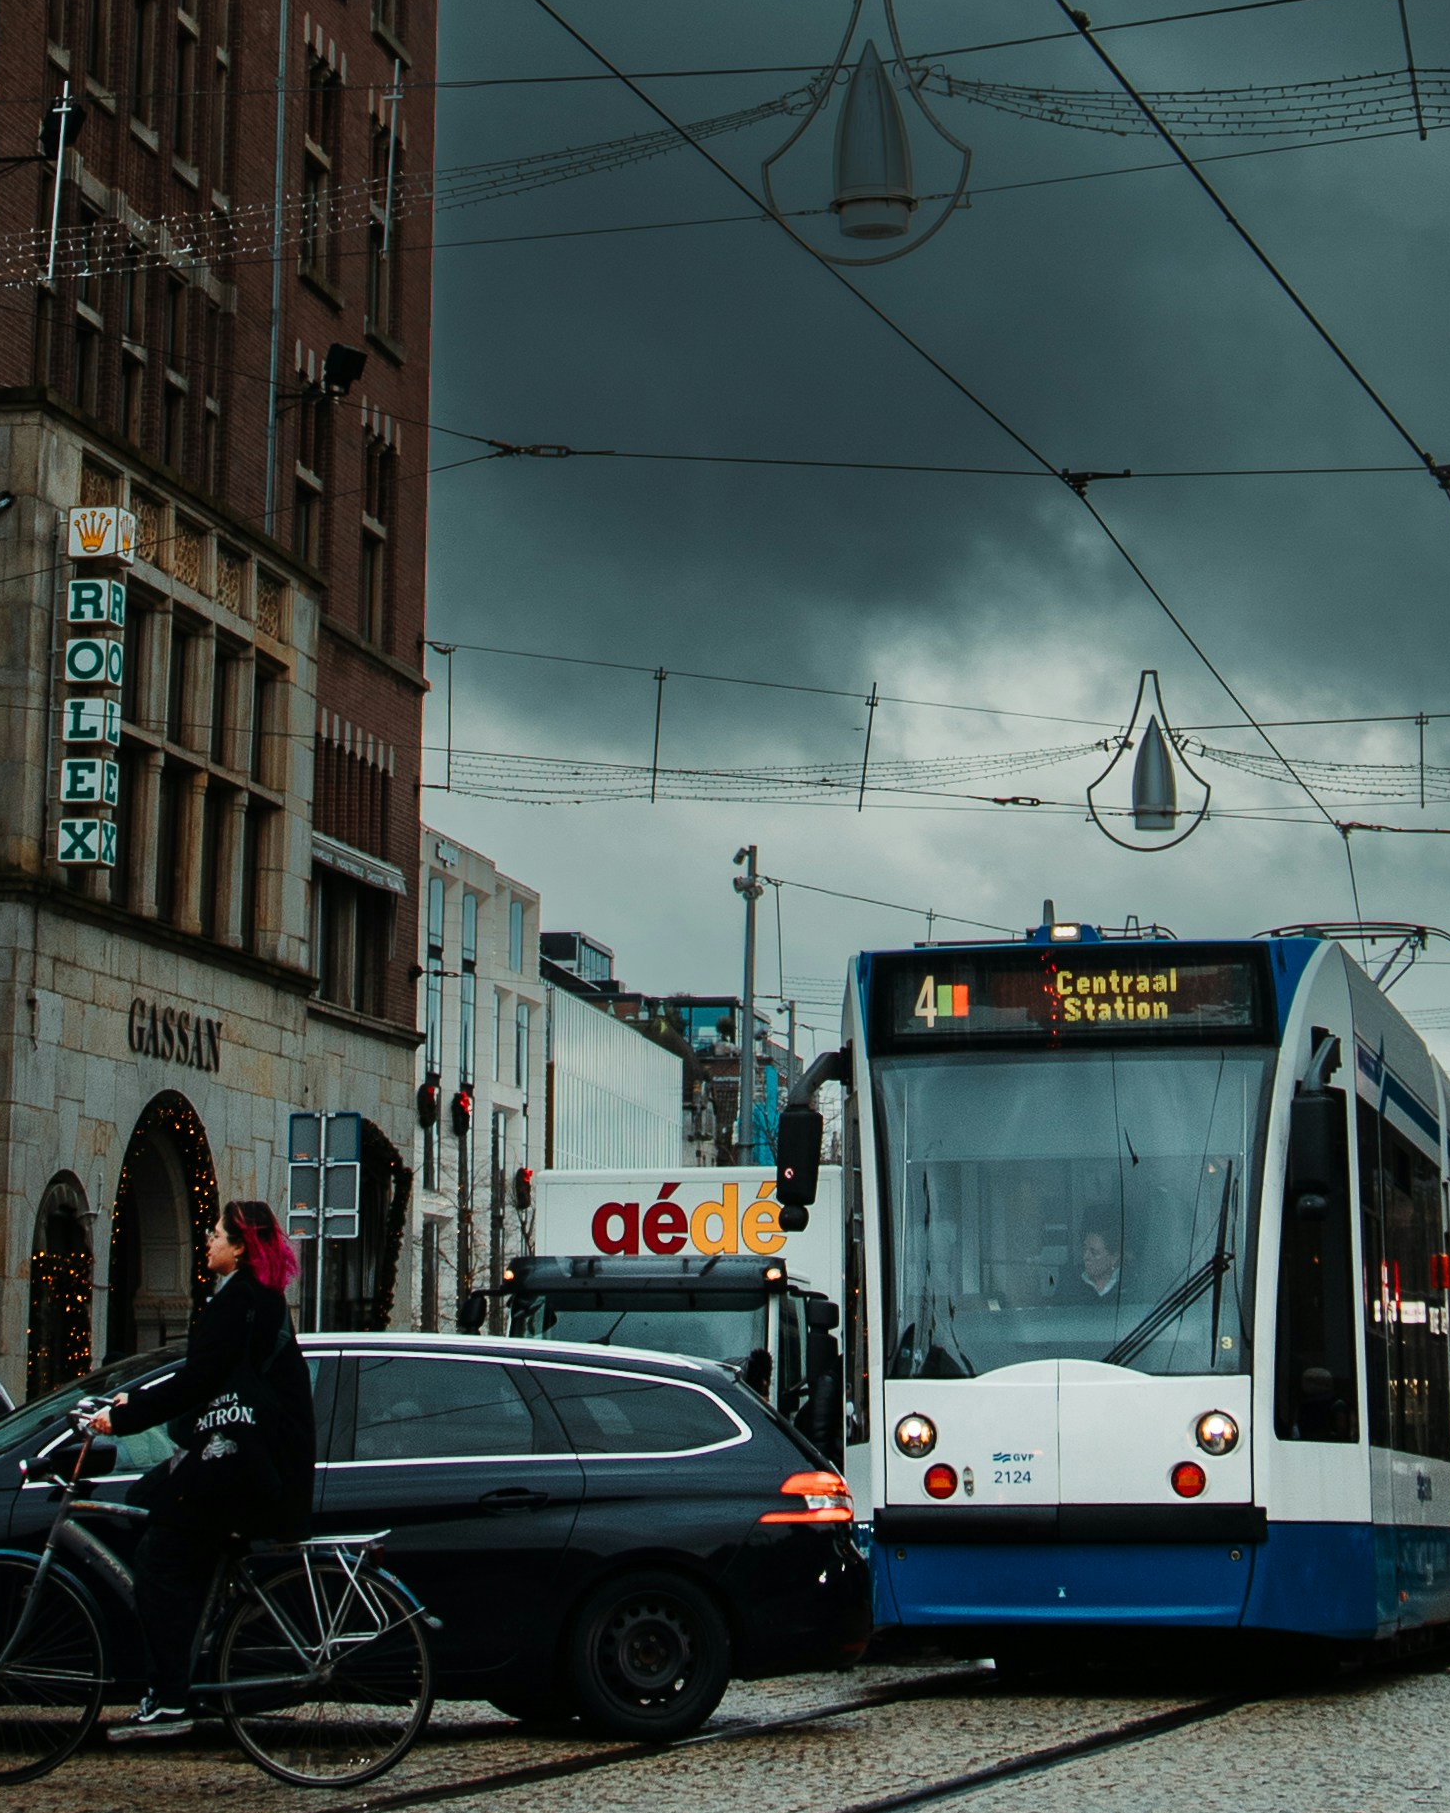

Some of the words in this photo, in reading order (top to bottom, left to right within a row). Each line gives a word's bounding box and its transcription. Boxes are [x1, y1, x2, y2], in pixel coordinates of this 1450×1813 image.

[60, 582, 105, 861] ROLEX
[101, 583, 124, 868] ROLEX
[915, 975, 937, 1028] 4
[1057, 968, 1177, 996] Centraal
[1064, 996, 1169, 1022] Station
[128, 997, 223, 1075] GASSAN
[1221, 1336, 1233, 1350] 3
[994, 1470, 1031, 1484] 2124
